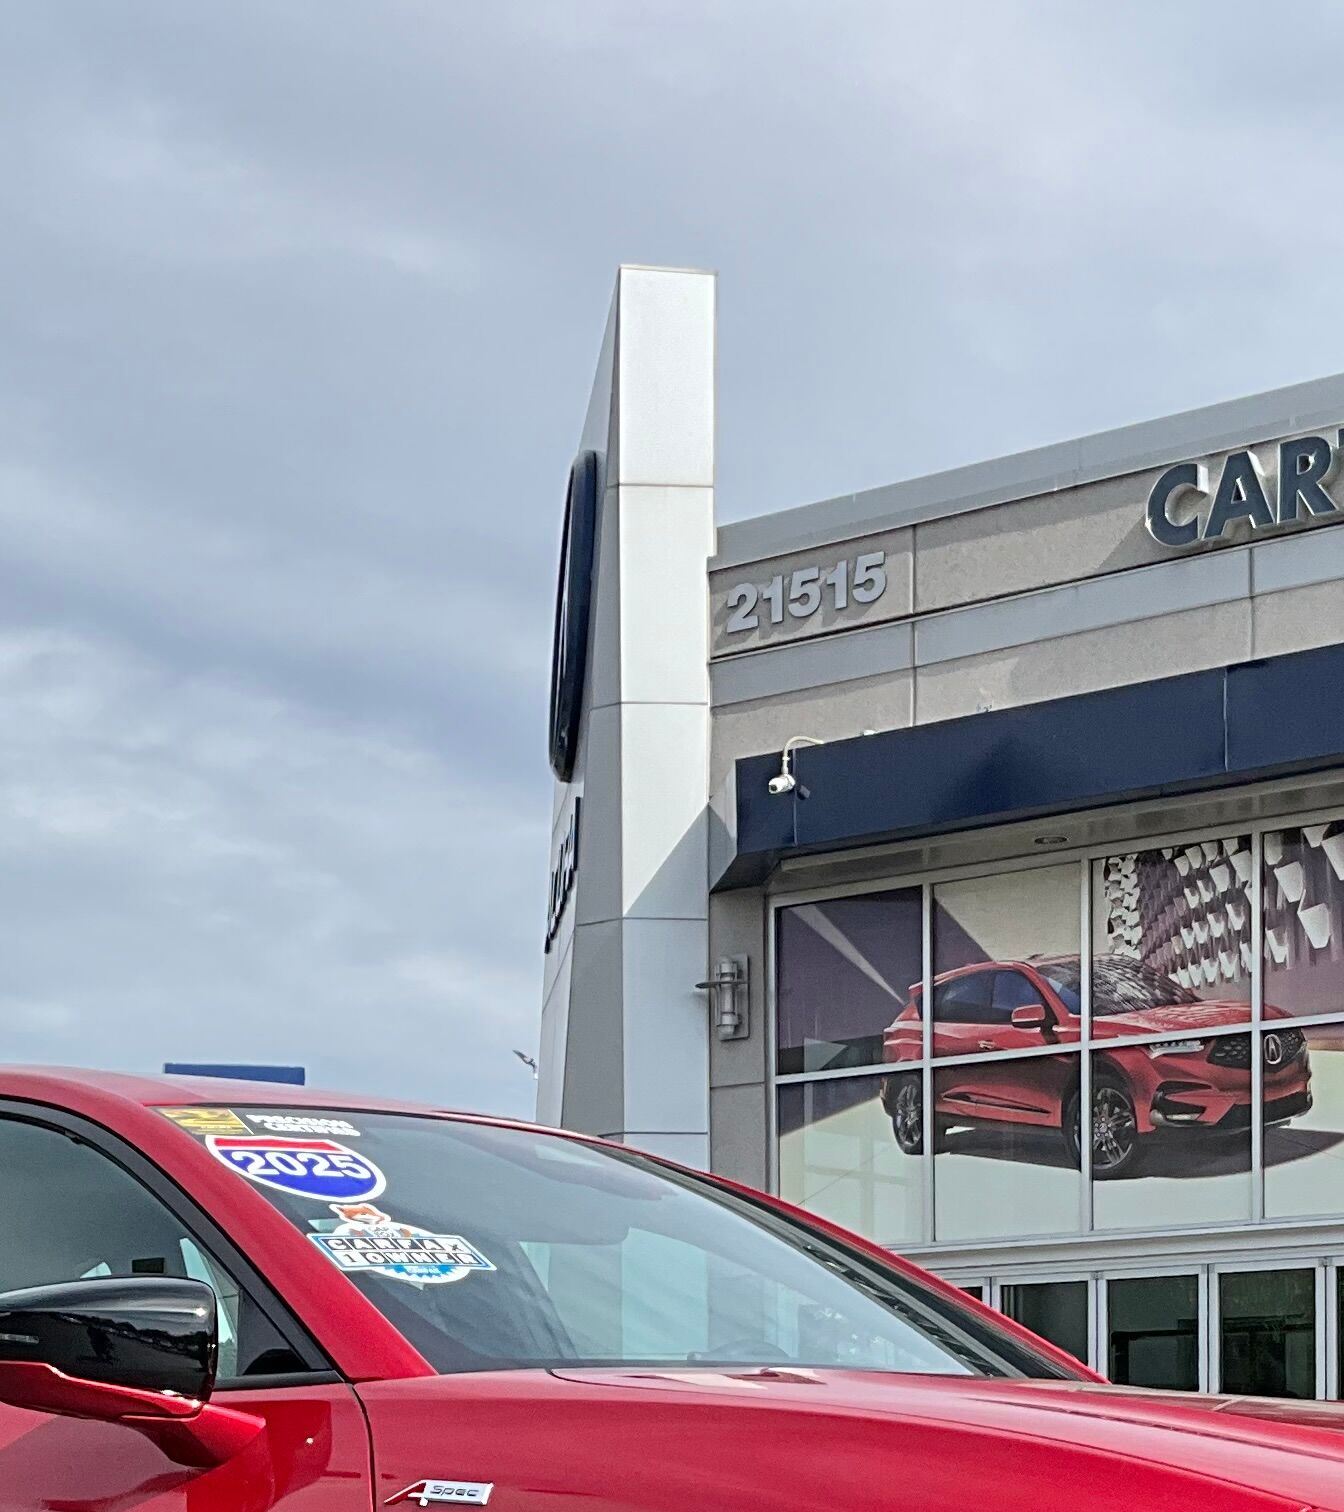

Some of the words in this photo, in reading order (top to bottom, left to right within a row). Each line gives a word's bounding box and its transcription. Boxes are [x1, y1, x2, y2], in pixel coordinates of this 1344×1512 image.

[727, 551, 887, 633] 21515
[231, 1151, 372, 1179] 2025
[327, 1238, 471, 1252] CARFAX
[365, 1252, 480, 1264] OWNER
